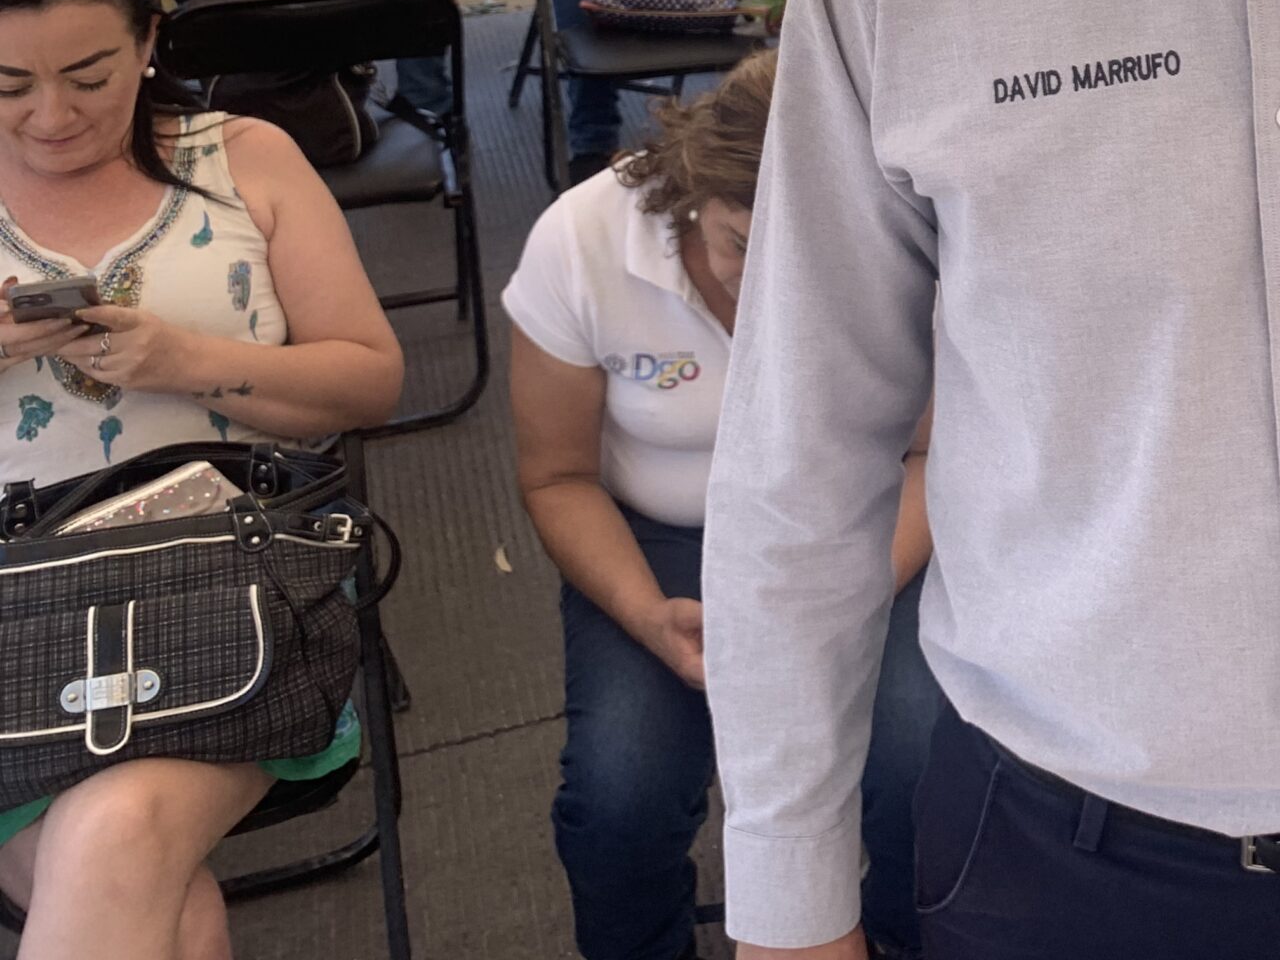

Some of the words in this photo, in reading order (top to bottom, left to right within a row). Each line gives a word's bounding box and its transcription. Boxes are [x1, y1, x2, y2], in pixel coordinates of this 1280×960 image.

[993, 69, 1063, 104] DAVID
[1071, 49, 1181, 92] MARRUFO
[634, 353, 700, 390] Dgo
